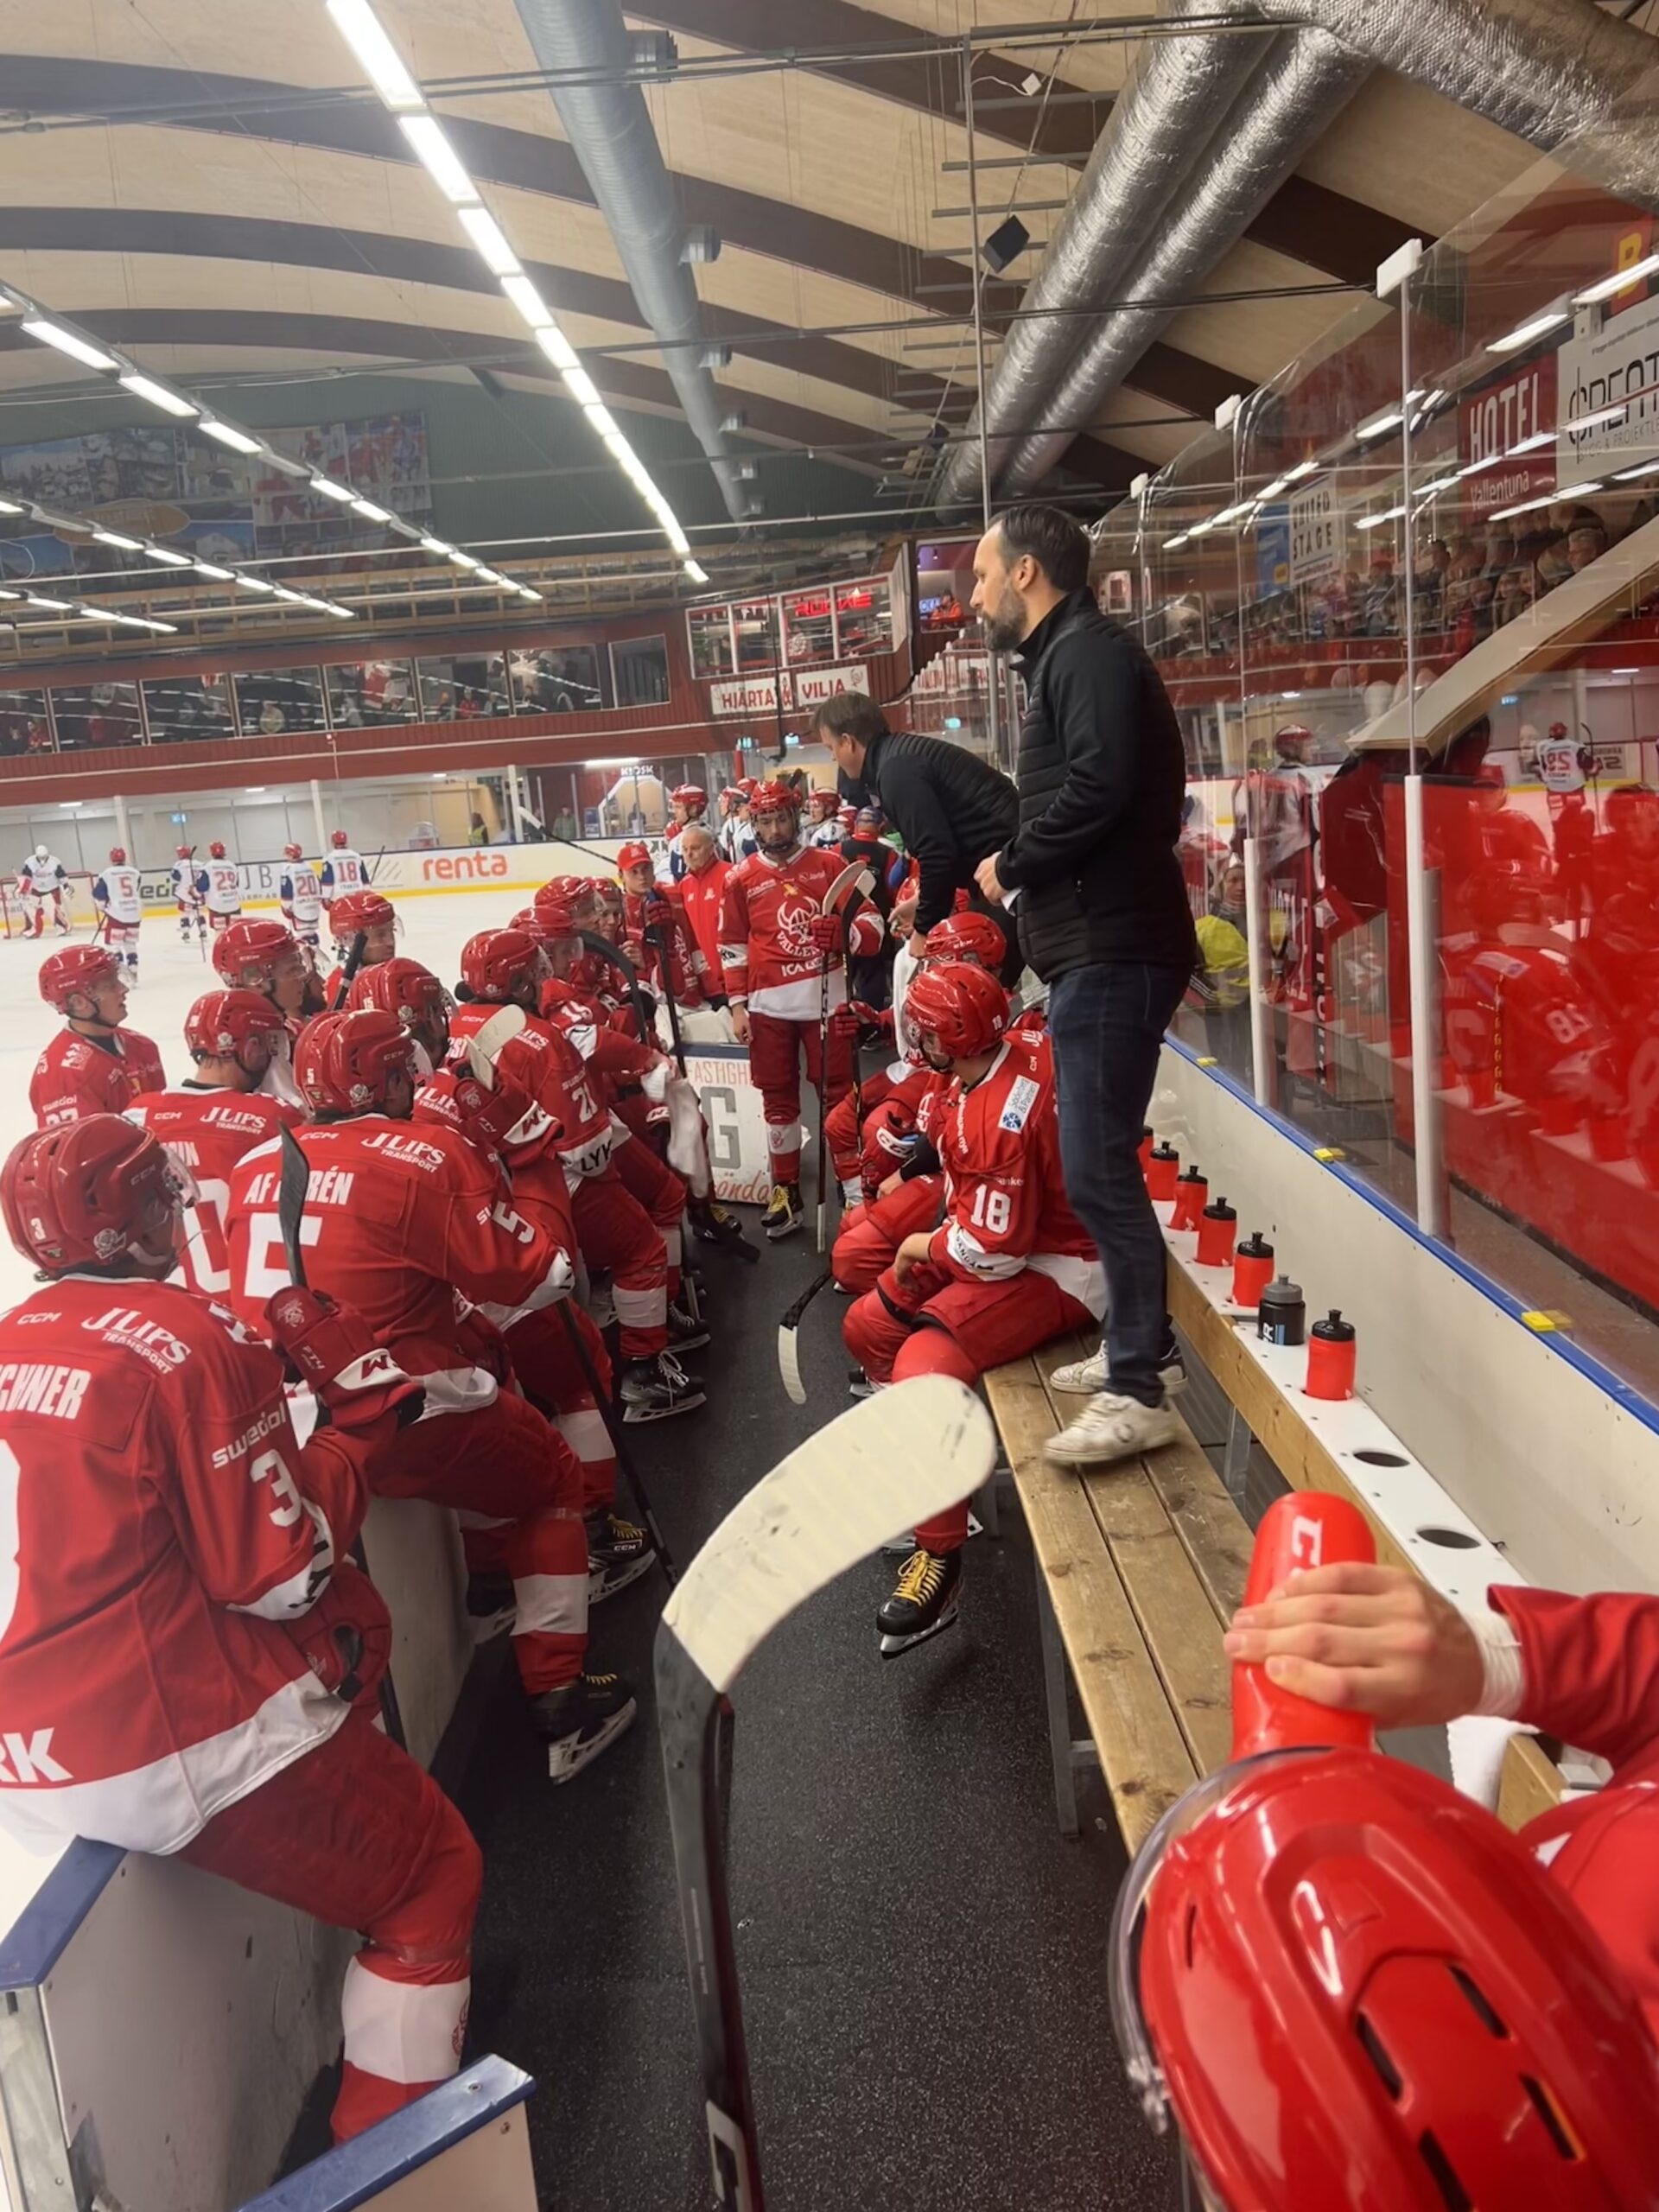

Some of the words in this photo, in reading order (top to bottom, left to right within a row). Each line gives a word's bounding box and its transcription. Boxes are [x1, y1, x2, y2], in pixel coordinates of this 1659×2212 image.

[1470, 372, 1543, 464] HOTEL
[1471, 471, 1529, 511] Vallentuna
[1293, 522, 1332, 560] STAGE
[722, 686, 775, 709] HJÄRTA
[802, 678, 845, 699] VILJA
[620, 765, 654, 776] KIOSK
[336, 861, 357, 883] 18
[423, 850, 508, 881] renta
[119, 876, 133, 898] 5
[214, 871, 237, 892] 29
[295, 874, 317, 897] 20
[781, 963, 805, 977] ICA
[384, 1049, 404, 1061] CCM
[307, 1067, 315, 1084] 5
[299, 1132, 340, 1141] CCM
[700, 1086, 741, 1169] G
[380, 1148, 438, 1173] TRANSPORT
[130, 1163, 157, 1185] CCM
[243, 1172, 276, 1205] AF
[491, 1199, 536, 1244] 5
[970, 1183, 1012, 1236] 18
[31, 1217, 47, 1241] 3
[17, 1312, 62, 1325] CCM
[101, 1331, 175, 1376] TRANSPORT
[212, 1401, 286, 1470] swedol
[250, 1447, 303, 1528] 3
